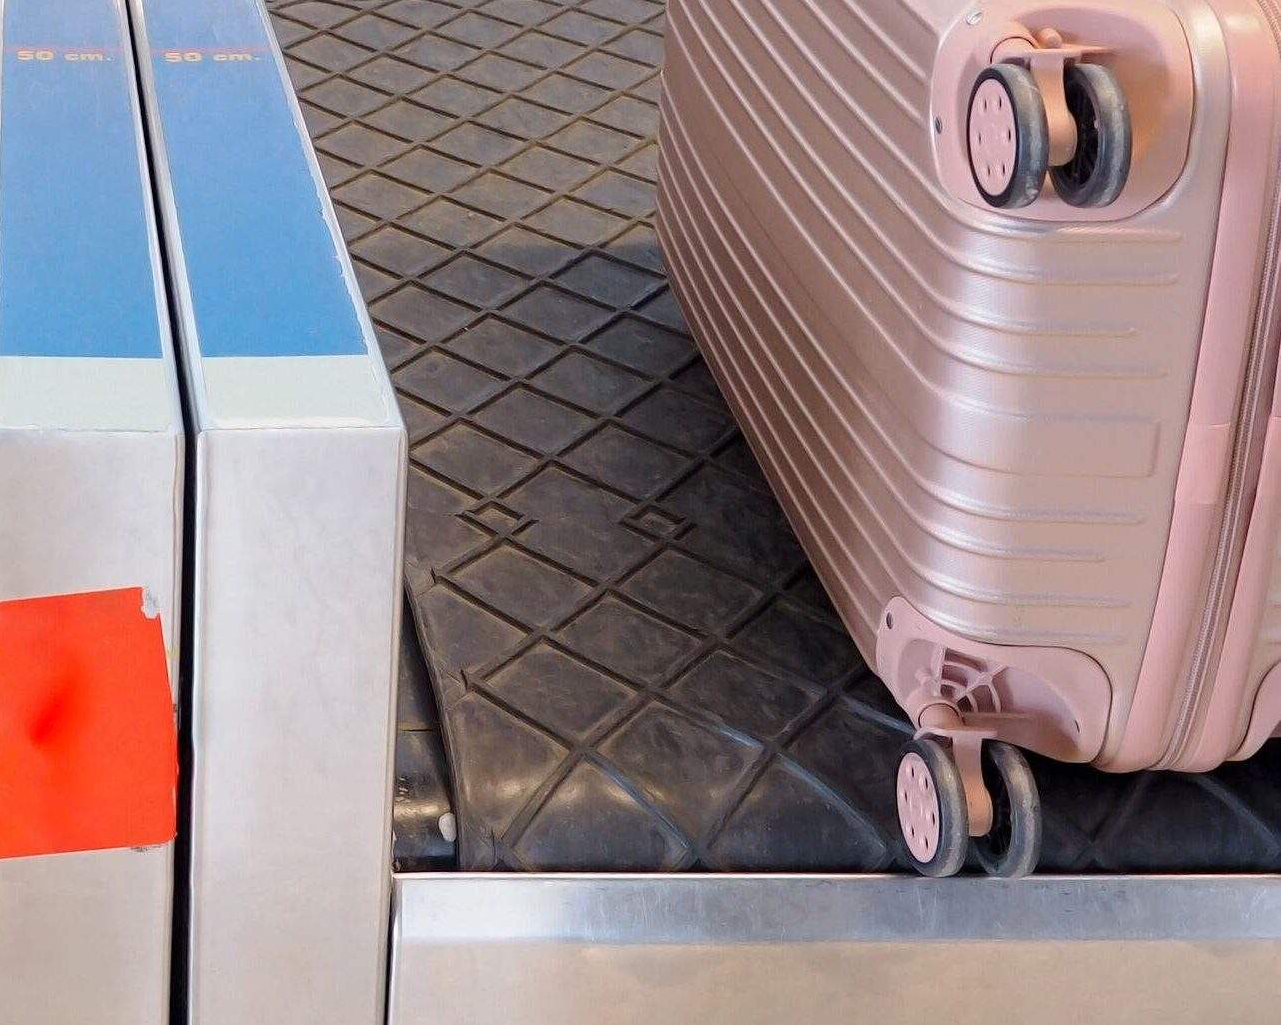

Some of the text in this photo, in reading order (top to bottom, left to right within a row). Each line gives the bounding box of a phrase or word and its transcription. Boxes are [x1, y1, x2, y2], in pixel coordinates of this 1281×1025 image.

[16, 49, 113, 62] 50 cm.
[164, 50, 260, 63] 50 cm.
